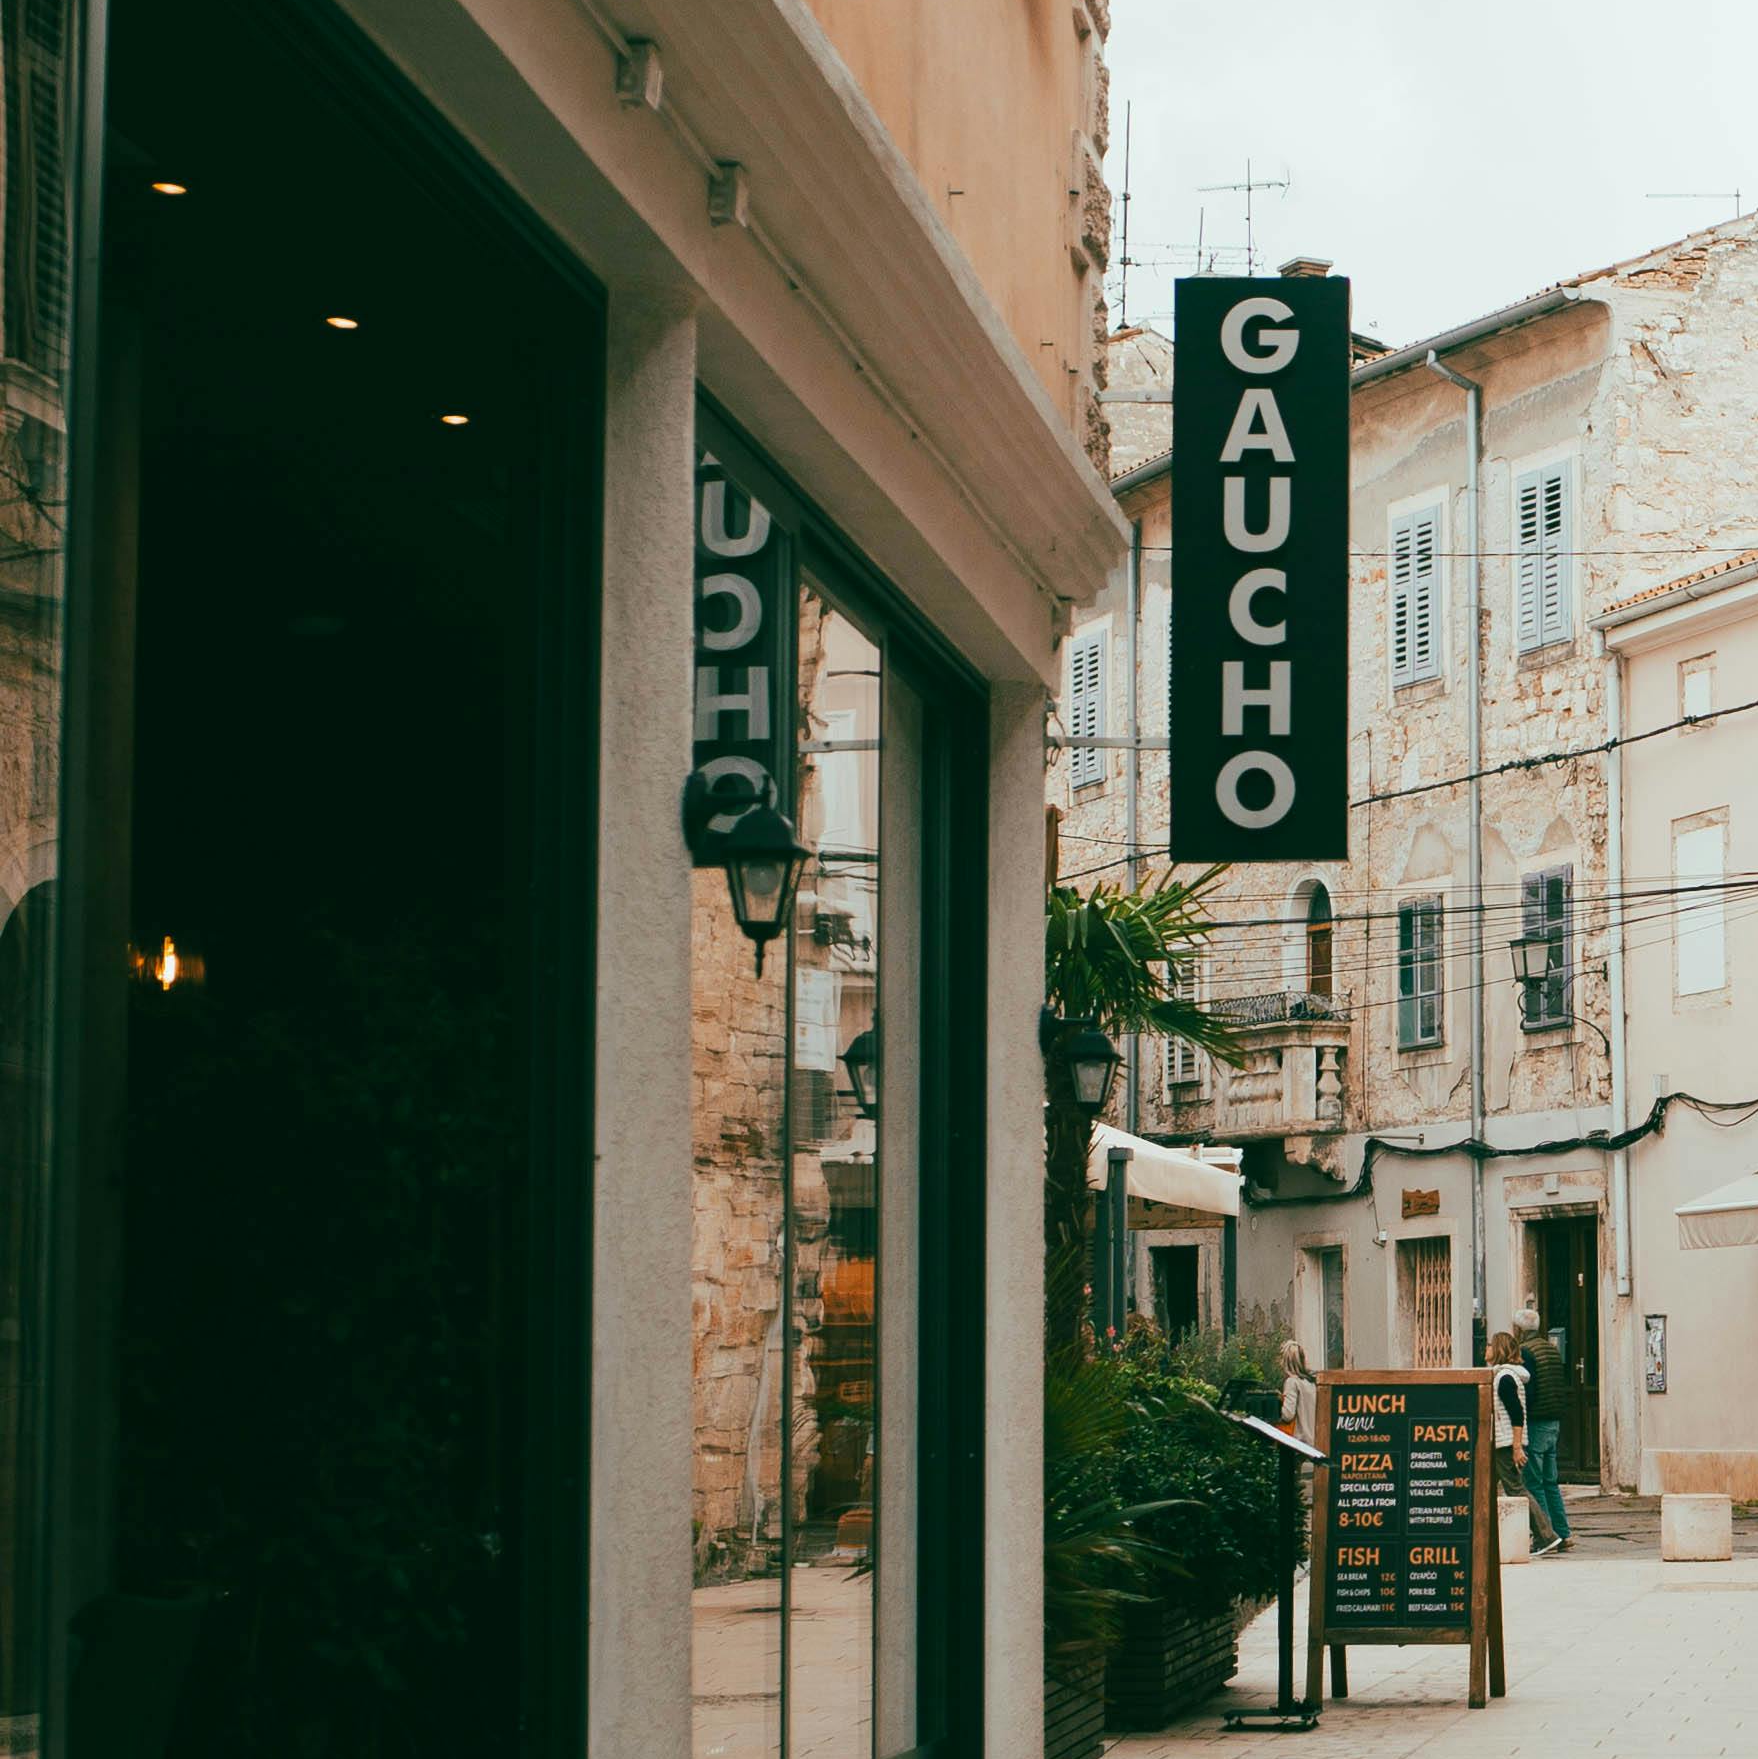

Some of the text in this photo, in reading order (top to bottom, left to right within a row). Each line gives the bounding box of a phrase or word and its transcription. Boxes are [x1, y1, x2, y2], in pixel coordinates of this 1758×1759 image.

[1216, 297, 1300, 829] GAUCHO
[1338, 1395, 1405, 1413] LUNCH
[1414, 1425, 1469, 1442] PASTA
[1456, 1451, 1470, 1461] 9€
[1342, 1454, 1392, 1471] PIZZA
[1340, 1483, 1395, 1492] SPECIAL OFFER
[1455, 1478, 1470, 1487] 10€
[1338, 1498, 1397, 1507] ALL PIZZA FROM
[1454, 1505, 1469, 1515] 15€
[1339, 1512, 1384, 1527] 8-10€
[1338, 1547, 1380, 1566] FISH
[1409, 1547, 1460, 1564] GRILL
[1381, 1573, 1396, 1581] 12€
[1454, 1570, 1465, 1580] 9€
[1380, 1587, 1396, 1596] 10€
[1450, 1587, 1465, 1596] 12€
